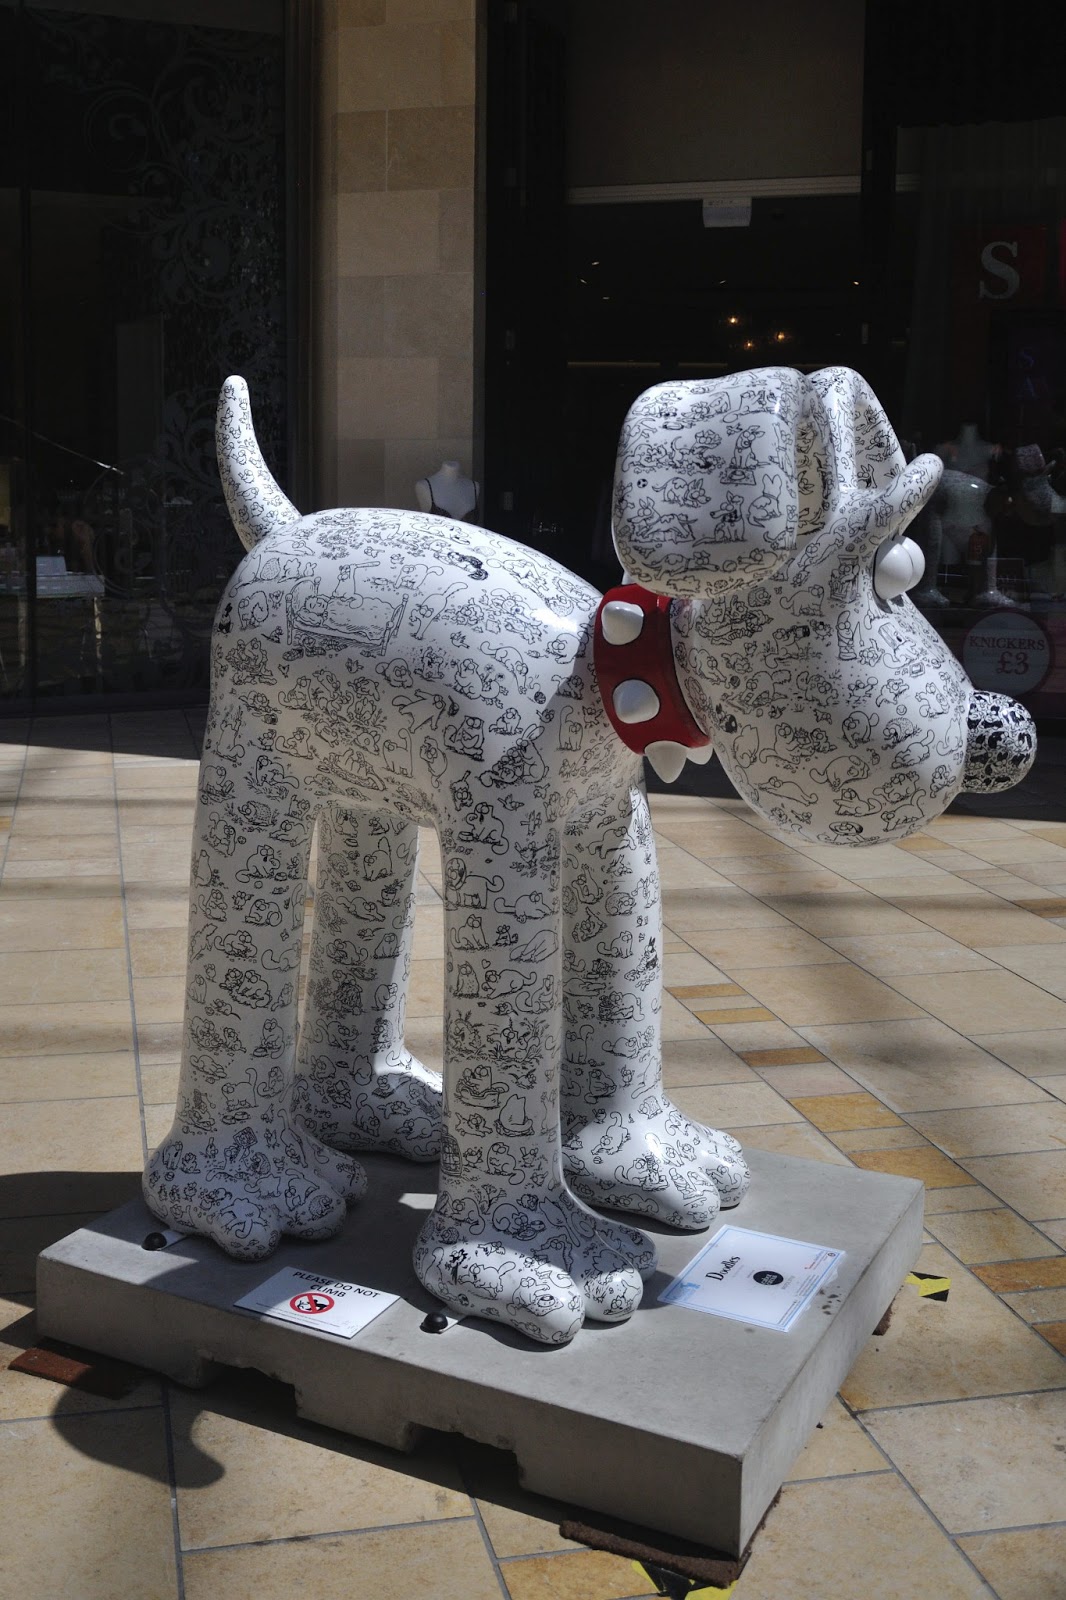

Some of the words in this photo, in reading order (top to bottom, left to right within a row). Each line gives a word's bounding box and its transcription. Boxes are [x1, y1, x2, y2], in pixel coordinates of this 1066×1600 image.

[979, 240, 1021, 301] S
[969, 636, 1045, 651] KNICKERS
[996, 651, 1029, 675] £3
[292, 1271, 334, 1286] PLEASE
[334, 1281, 353, 1291] DO
[354, 1287, 381, 1299] NOT
[310, 1284, 347, 1298] CLIMB
